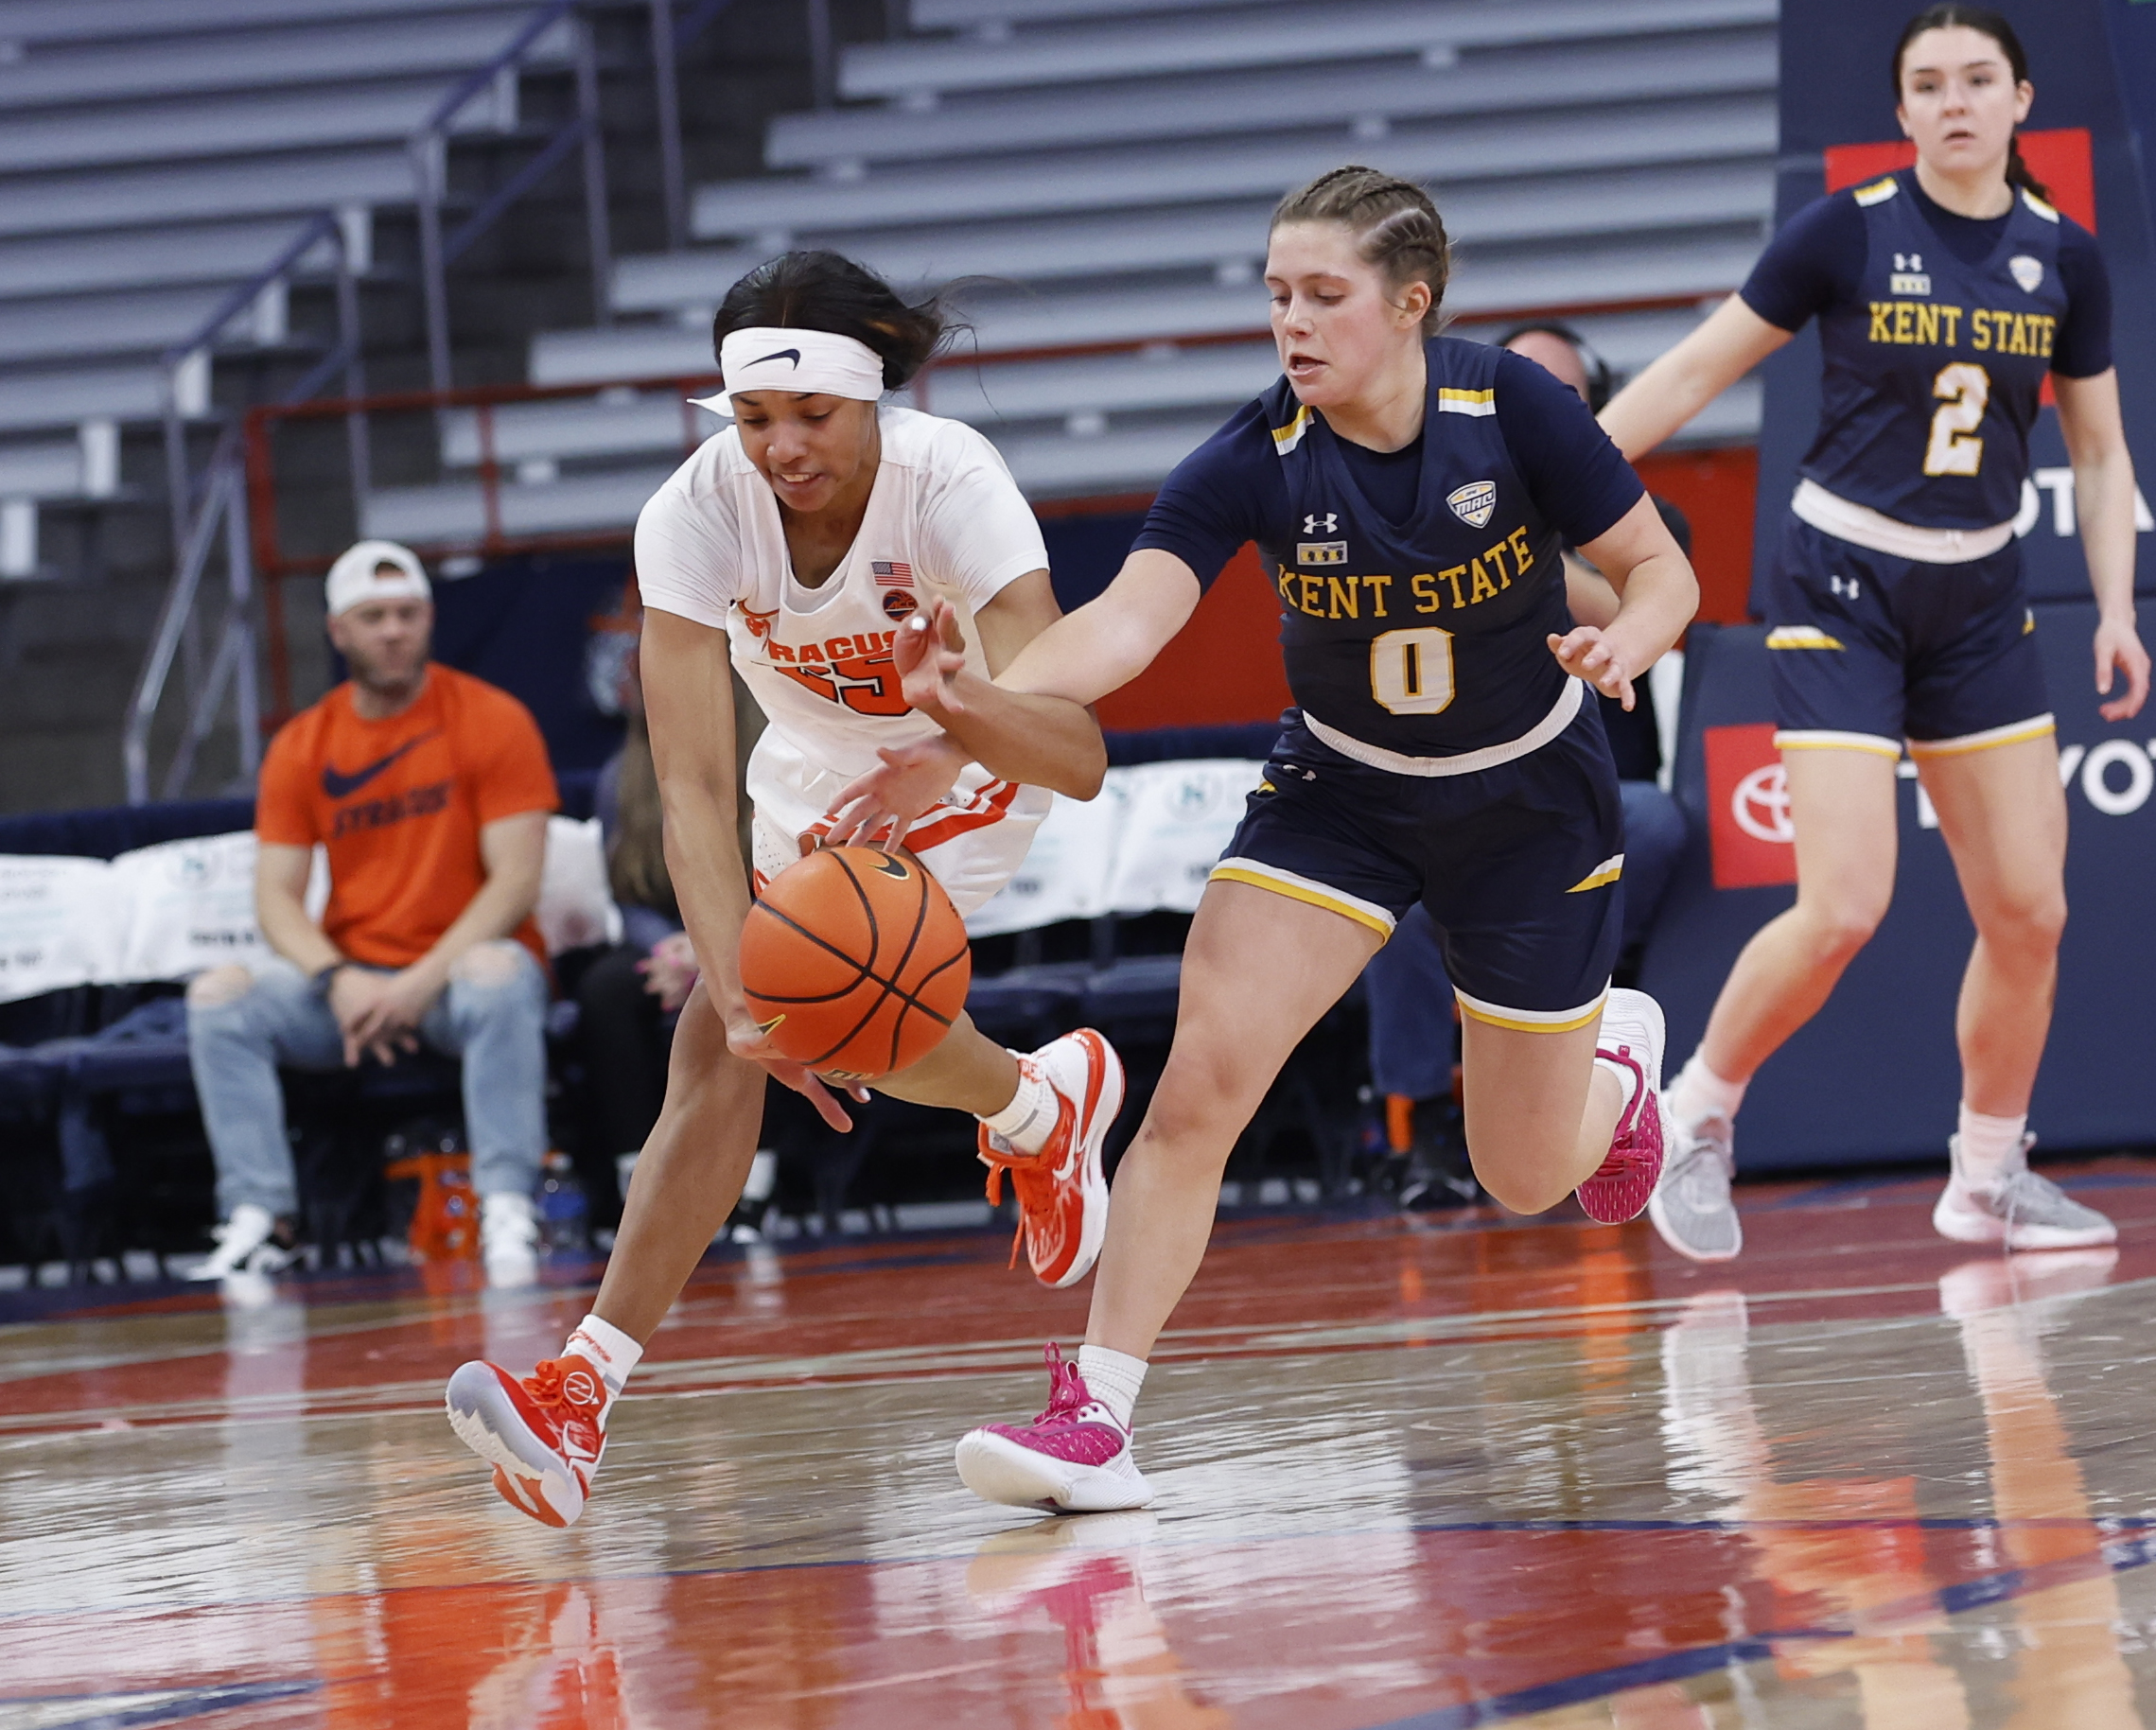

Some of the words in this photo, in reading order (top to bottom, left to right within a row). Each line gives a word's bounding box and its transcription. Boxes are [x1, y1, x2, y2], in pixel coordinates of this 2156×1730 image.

[1867, 300, 1963, 348] KENT
[1971, 307, 2058, 358] STATE
[1921, 360, 1992, 477] 2
[1453, 491, 1496, 517] MAC
[1278, 563, 1393, 620] KENT
[1411, 524, 1535, 615] STATE
[1370, 625, 1456, 716] 0
